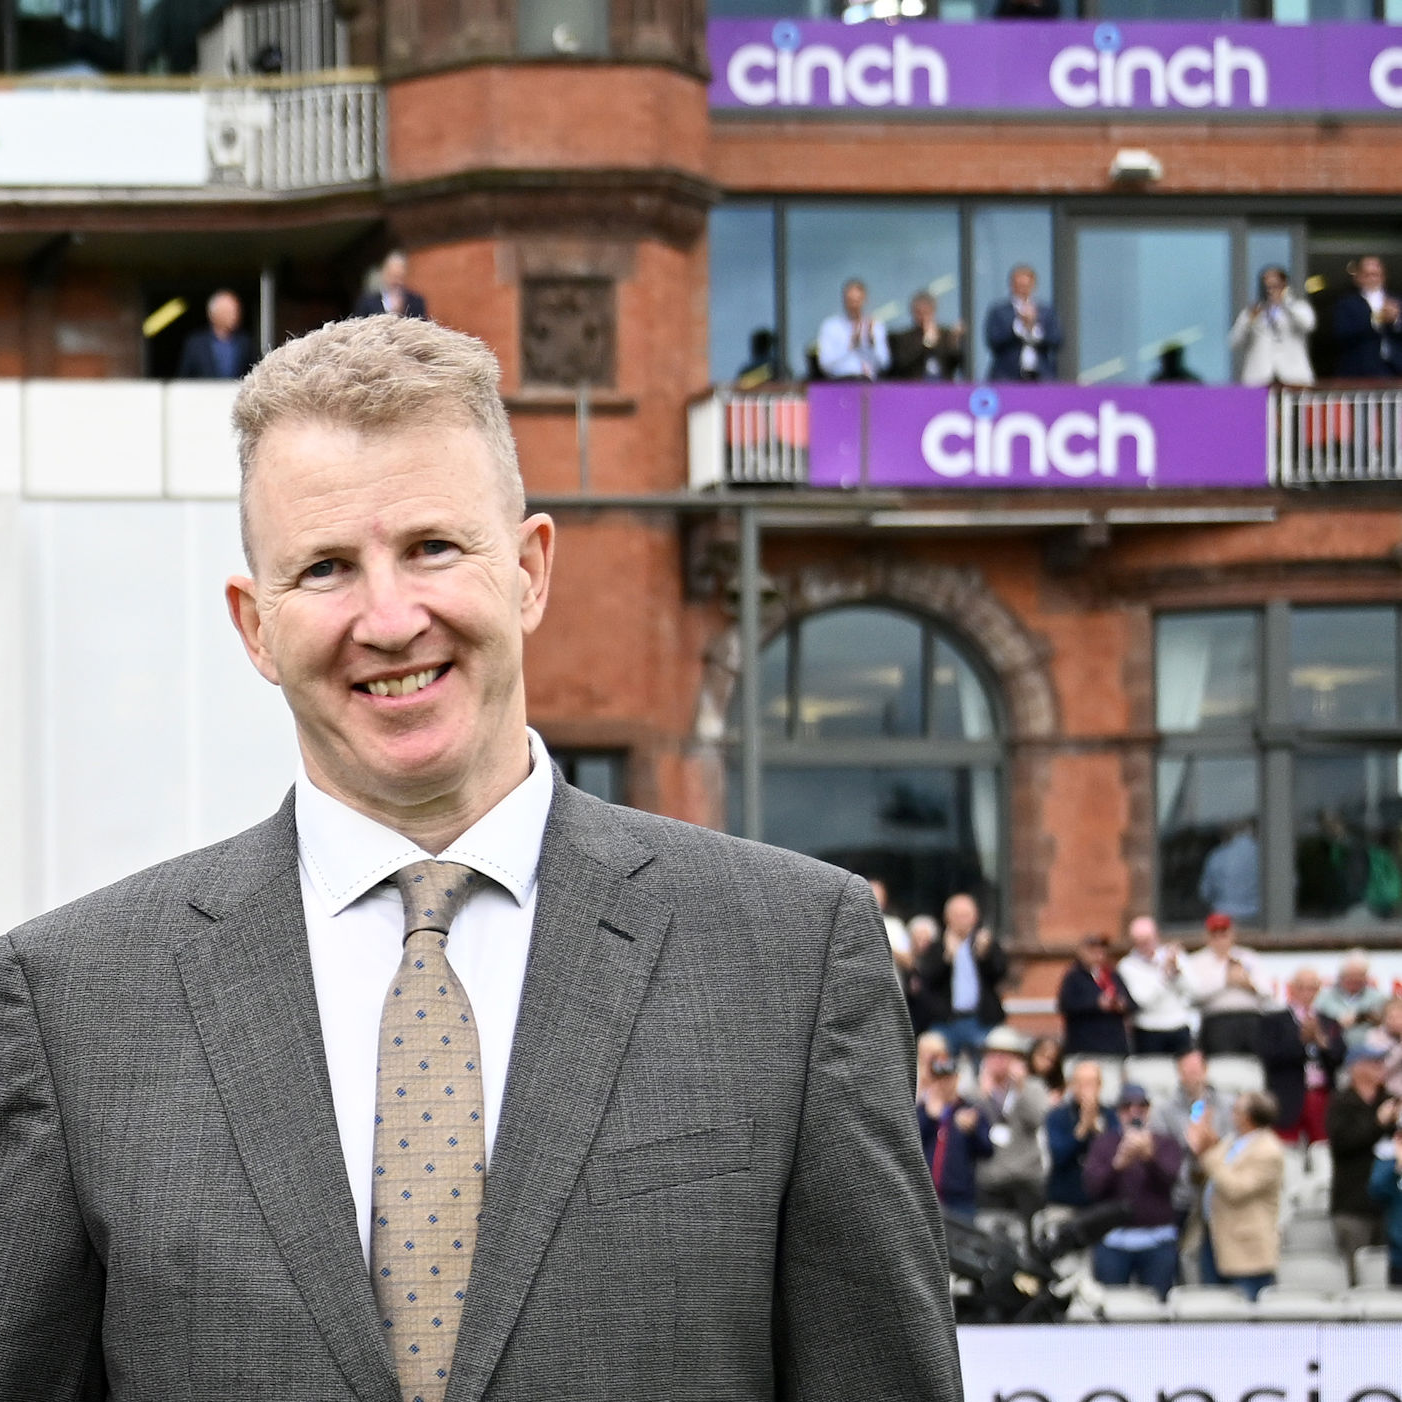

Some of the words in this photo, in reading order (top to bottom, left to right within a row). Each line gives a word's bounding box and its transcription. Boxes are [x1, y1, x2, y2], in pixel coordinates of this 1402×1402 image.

[727, 21, 950, 107] cinch
[1049, 22, 1269, 108] cinch
[921, 387, 1156, 479] cinch
